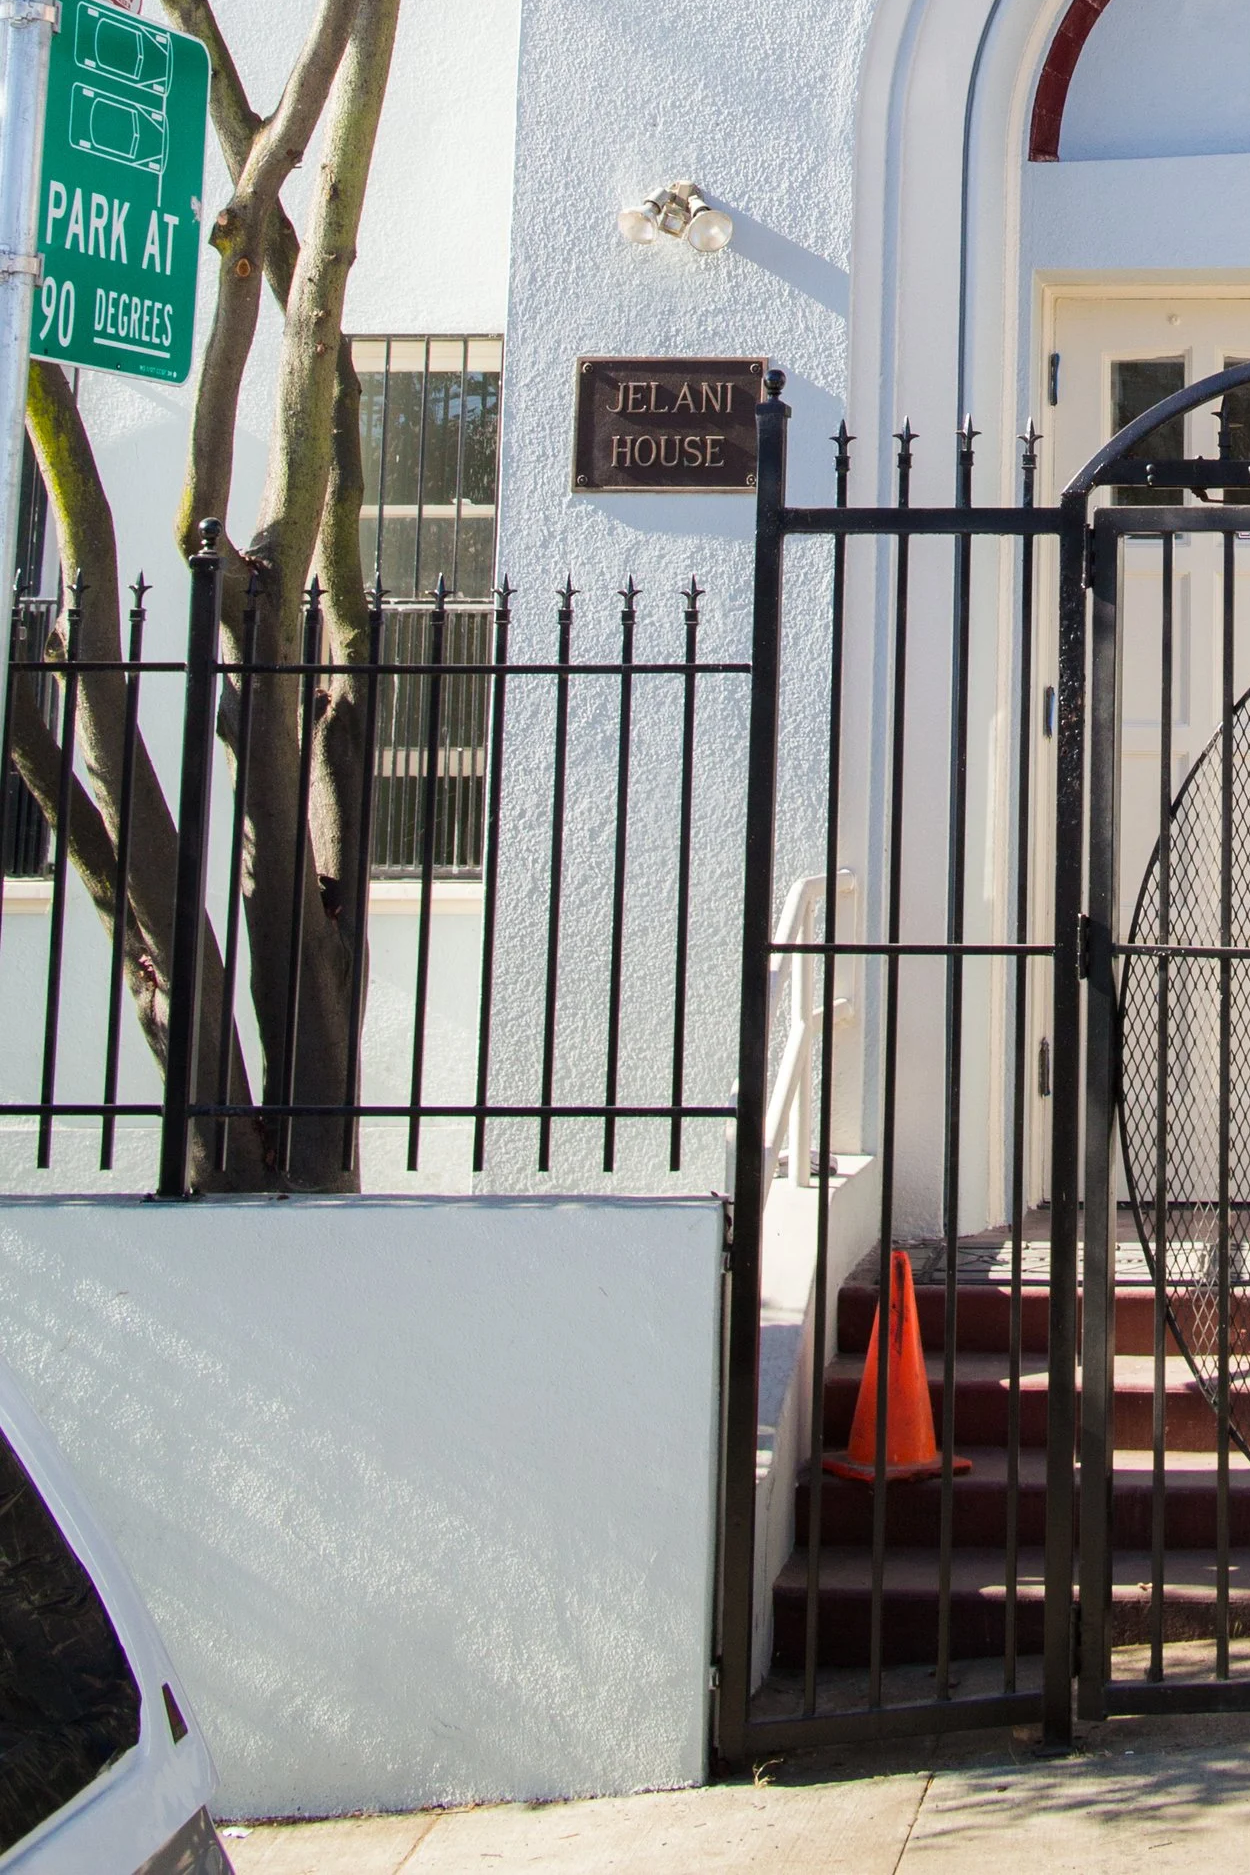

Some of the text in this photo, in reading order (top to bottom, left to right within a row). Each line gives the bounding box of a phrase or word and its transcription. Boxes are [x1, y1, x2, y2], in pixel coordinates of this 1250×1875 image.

[45, 179, 180, 276] PARK AT
[39, 276, 174, 348] 90 DEGREES
[606, 381, 735, 414] JELANI
[610, 435, 726, 468] HOUSE
